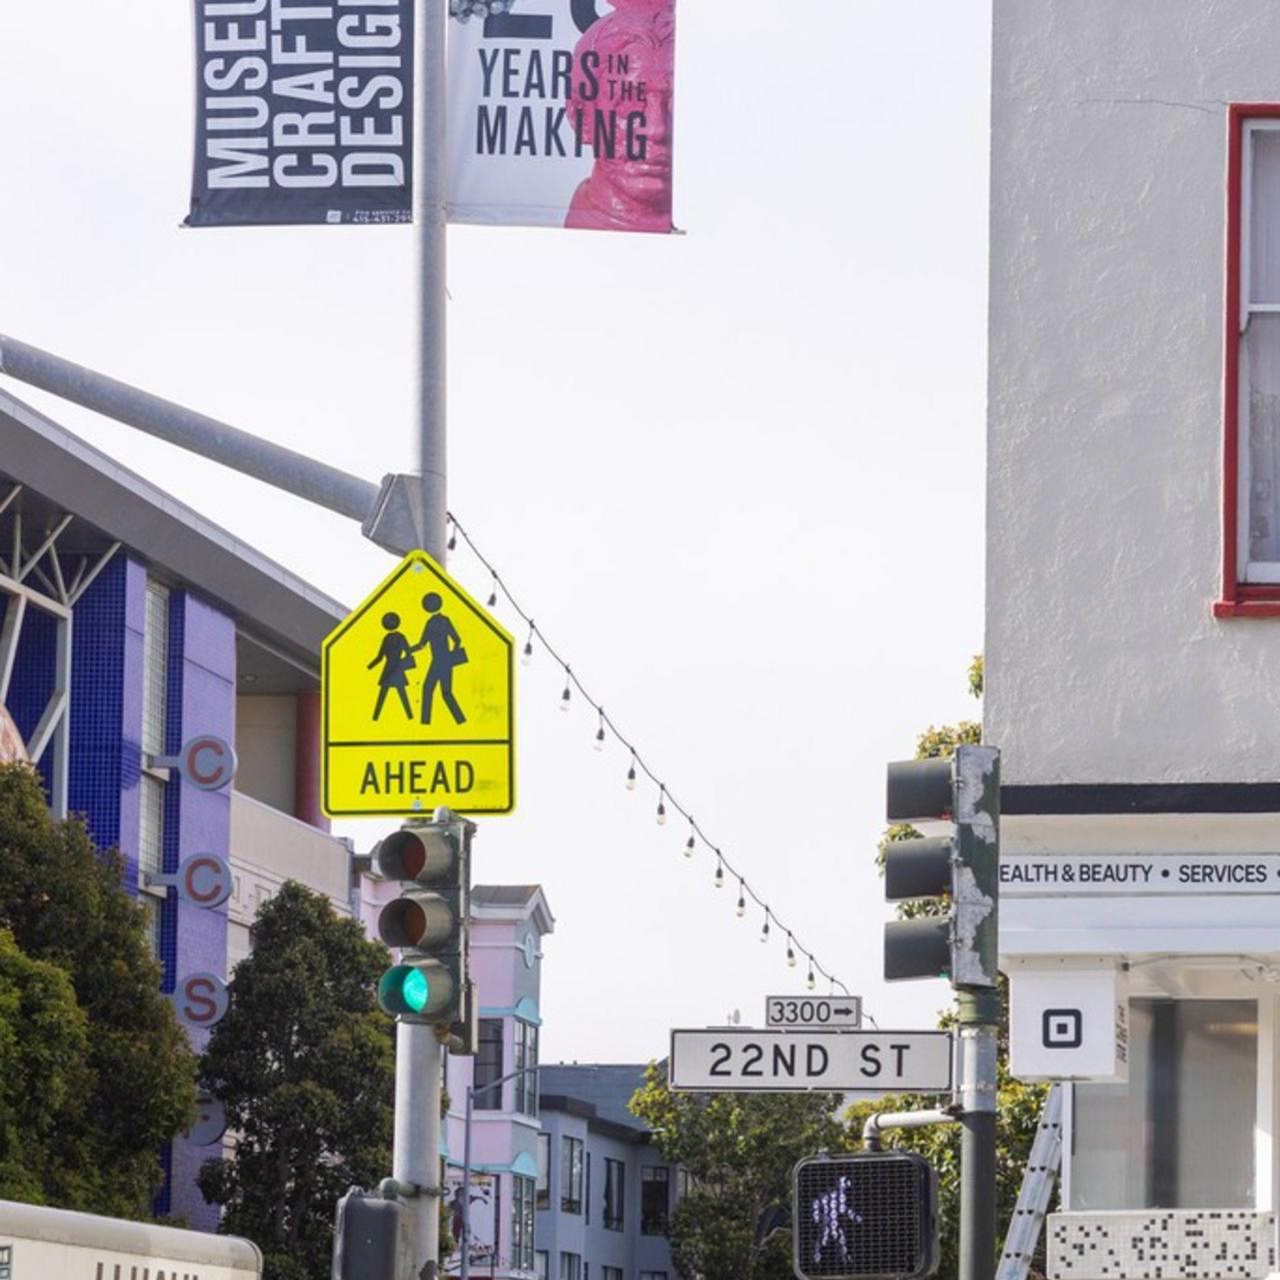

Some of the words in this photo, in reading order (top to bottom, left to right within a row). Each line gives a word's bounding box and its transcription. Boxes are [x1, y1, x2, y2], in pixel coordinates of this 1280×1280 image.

[478, 47, 601, 102] YEARS
[608, 54, 630, 73] IN
[272, 0, 338, 189] CRAFT
[607, 79, 647, 102] THE
[475, 105, 647, 162] MAKING
[360, 761, 474, 794] AHEAD
[1079, 864, 1153, 882] BEAUTY
[1179, 864, 1267, 882] SERVICES
[770, 1001, 831, 1023] 3300
[709, 1043, 829, 1077] 22ND
[859, 1043, 910, 1077] ST
